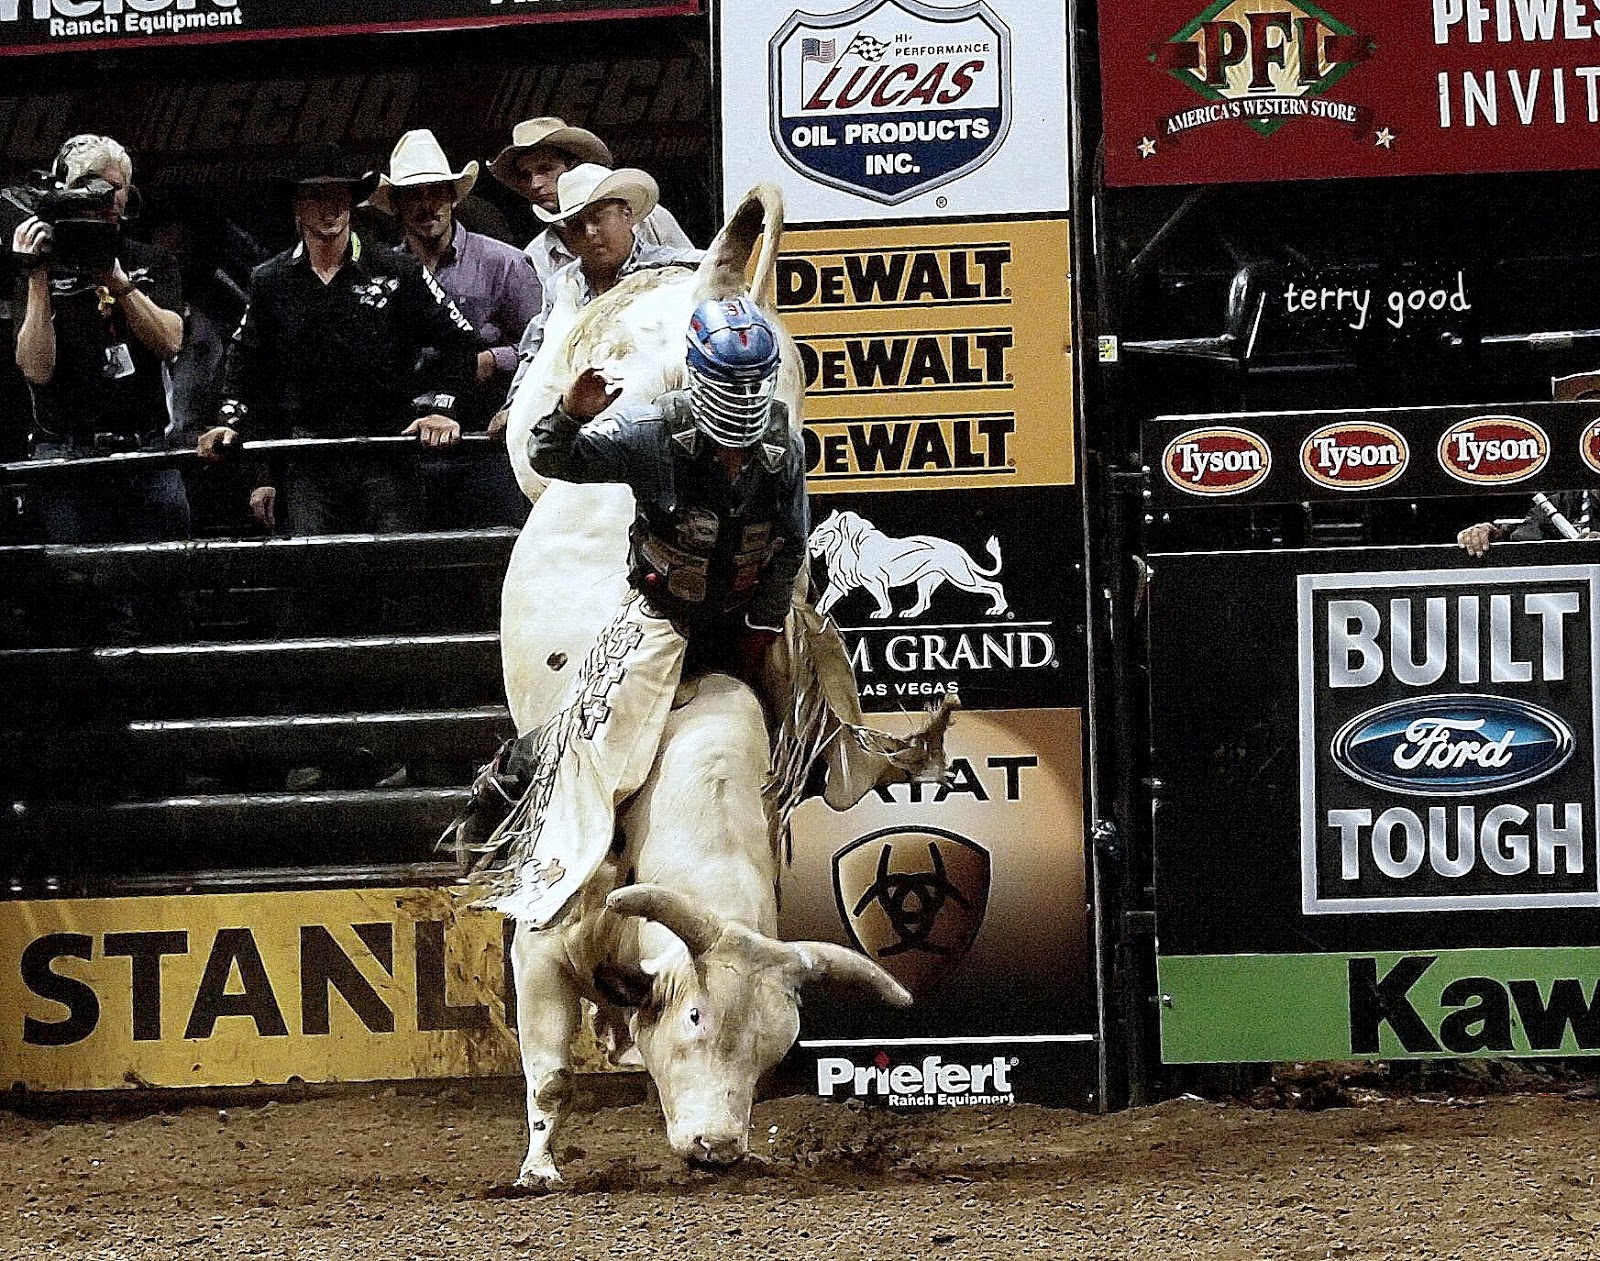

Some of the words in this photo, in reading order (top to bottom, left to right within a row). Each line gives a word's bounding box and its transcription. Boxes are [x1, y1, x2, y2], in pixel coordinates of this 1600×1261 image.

[50, 16, 118, 36] Ranch
[125, 7, 243, 34] Equipment
[1432, 0, 1600, 44] PFIWE
[895, 42, 990, 57] PERFORMANCE
[1203, 12, 1324, 89] PFI
[801, 60, 985, 111] LUCAS
[1437, 66, 1600, 128] INVIT
[791, 124, 836, 148] OIL
[845, 117, 991, 145] PRODUCTS
[1166, 101, 1241, 134] AMERICA'S
[1243, 99, 1308, 116] WESTERN
[1310, 99, 1357, 122] STORE
[865, 153, 921, 175] INC.
[1174, 443, 1262, 482] Tyson
[1313, 437, 1400, 477] Tyson
[1451, 431, 1540, 472] Tyson
[885, 632, 1055, 673] GRAND
[1328, 592, 1580, 689] BUILT
[857, 683, 888, 696] AS
[894, 681, 959, 695] VEGAS
[1393, 717, 1516, 770] Ford
[1327, 803, 1584, 881] TOUGH
[20, 920, 518, 1047] STANL
[1347, 955, 1600, 1055] Kaw
[817, 1051, 1012, 1096] Priefert
[889, 1094, 934, 1106] Ranch
[938, 1093, 1015, 1107] Equipment
